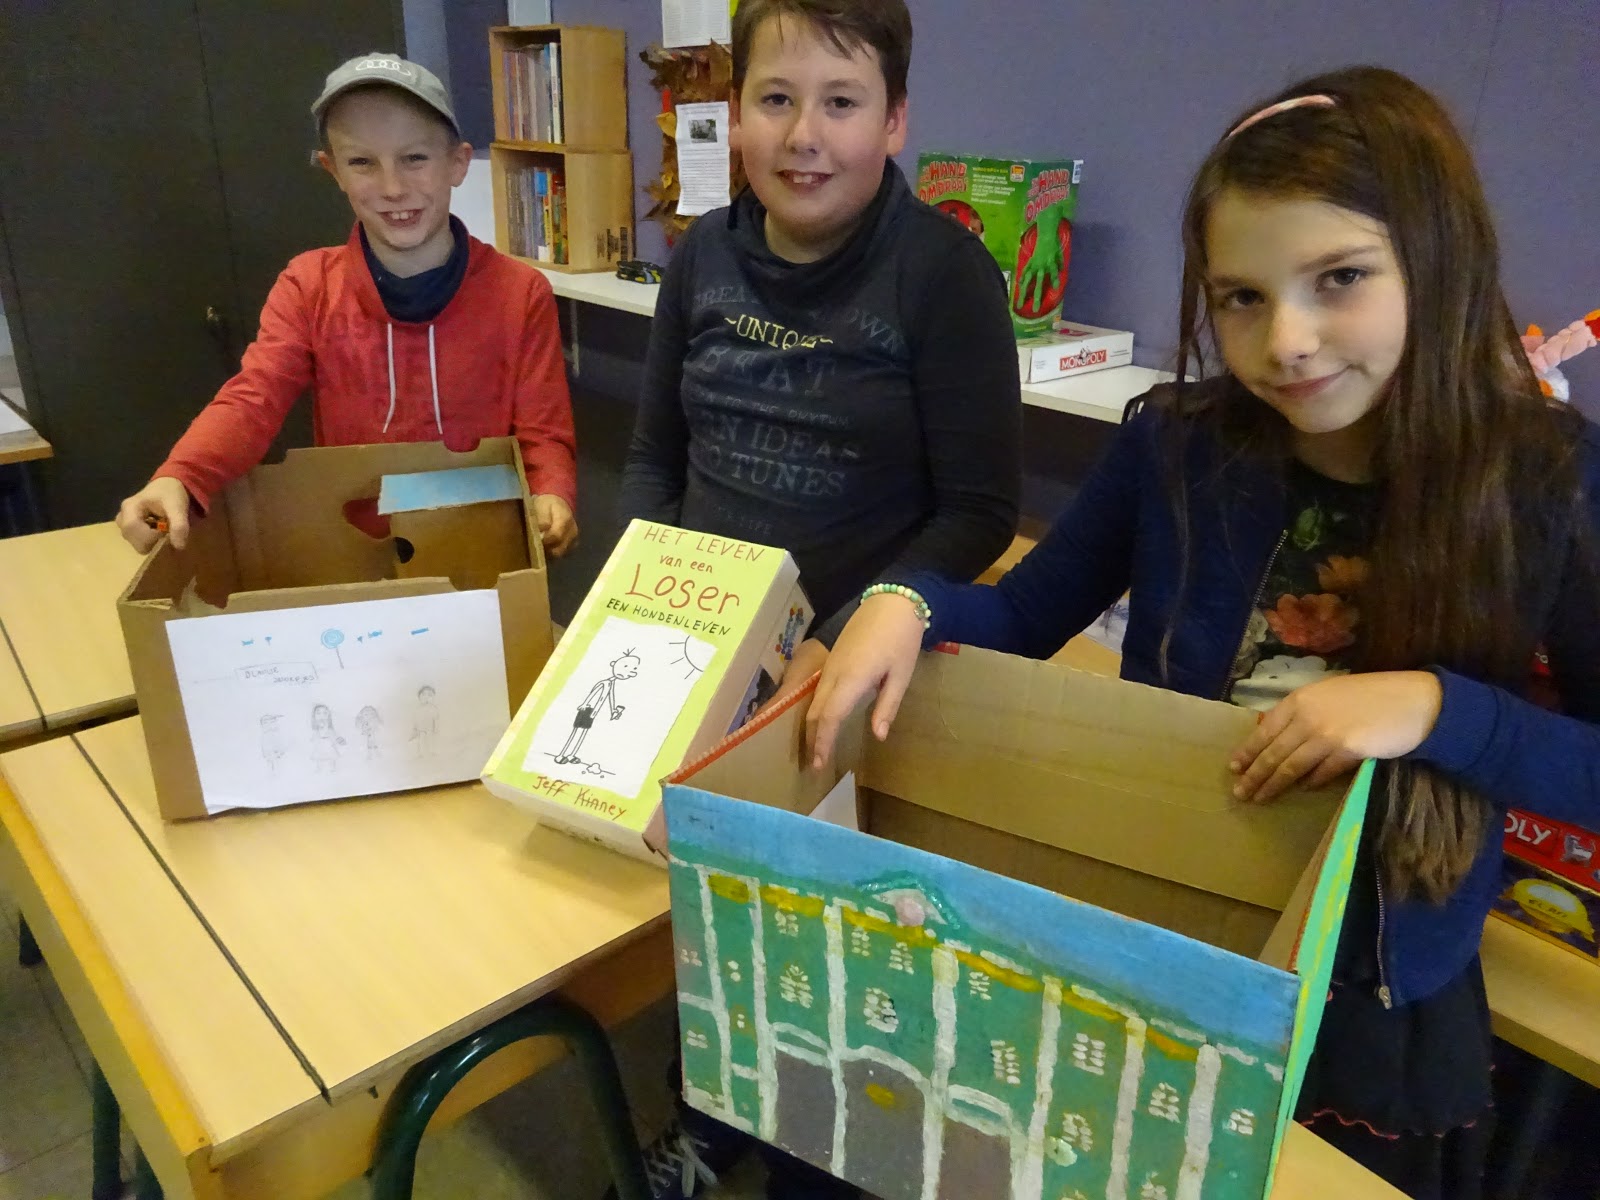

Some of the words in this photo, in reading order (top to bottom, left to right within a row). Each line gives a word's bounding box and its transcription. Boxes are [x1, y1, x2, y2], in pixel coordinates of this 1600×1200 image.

[929, 161, 968, 180] HAND
[1061, 351, 1106, 370] MONOPOLY
[643, 525, 689, 546] HET
[695, 536, 766, 562] LEVEN
[660, 554, 683, 568] van
[690, 561, 713, 574] een
[625, 563, 740, 615] Loser
[606, 598, 630, 612] EEN
[632, 604, 731, 637] HONDENLEVEN
[532, 775, 571, 804] Jeff
